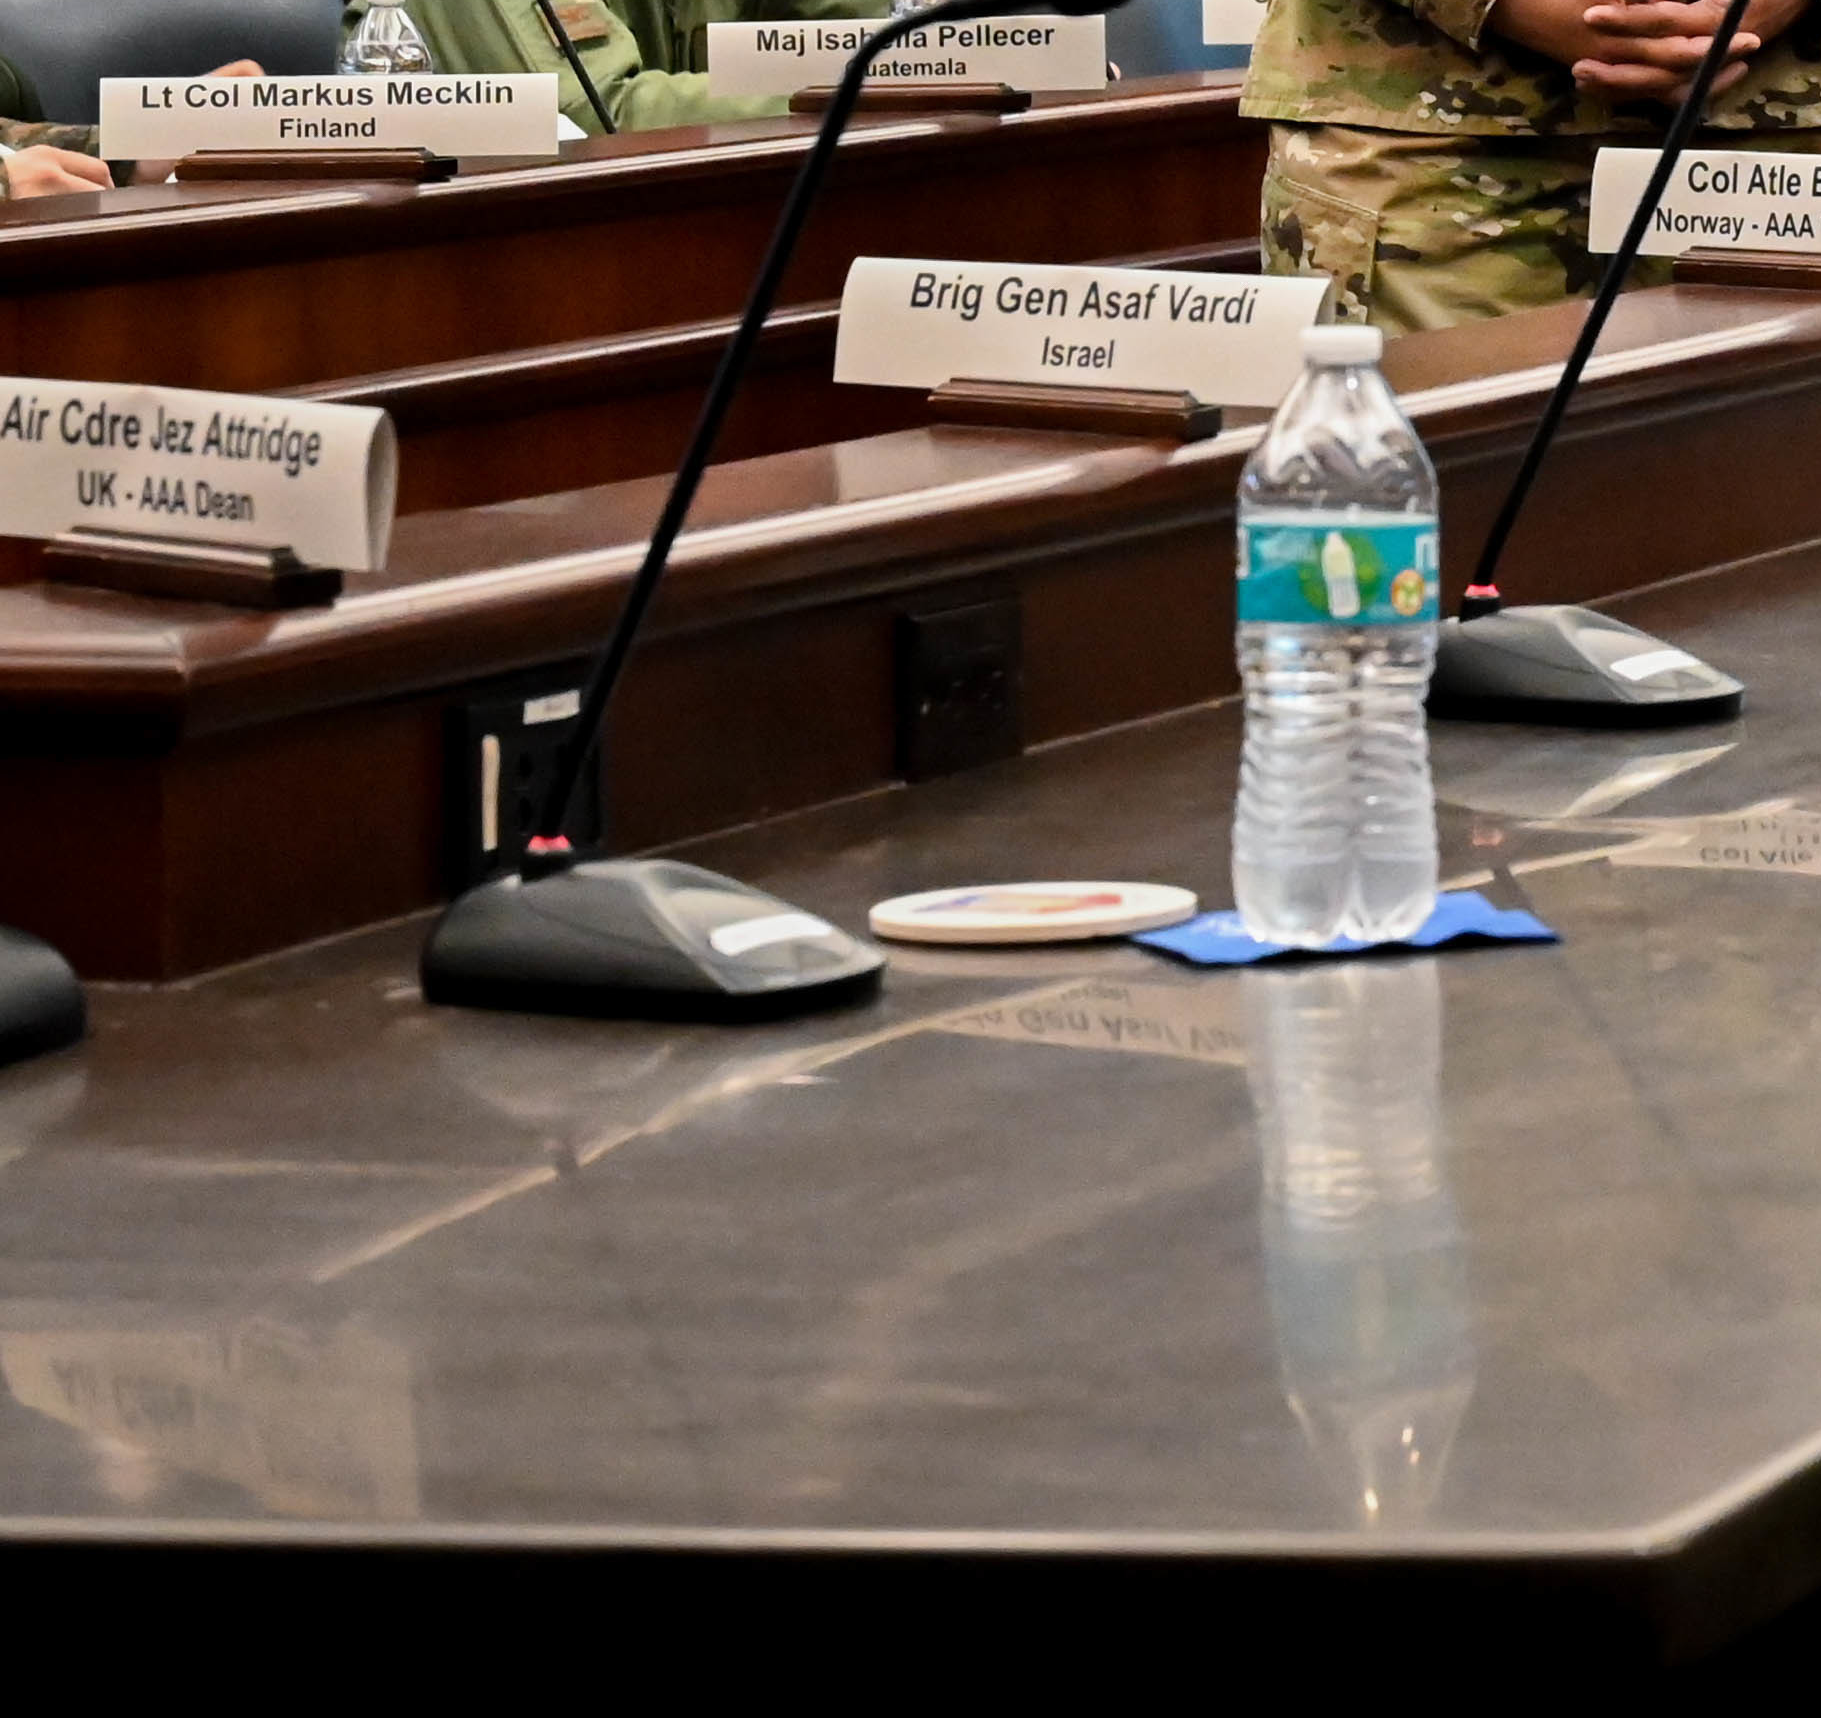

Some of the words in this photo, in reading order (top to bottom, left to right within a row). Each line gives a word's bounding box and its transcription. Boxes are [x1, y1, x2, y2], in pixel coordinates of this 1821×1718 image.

[756, 29, 805, 57] Maj
[938, 24, 1056, 47] Pellecer
[848, 58, 967, 78] uatemala
[141, 83, 172, 109] Lt
[184, 81, 240, 109] Col
[251, 79, 374, 108] Markus
[386, 78, 515, 106] Mecklin
[279, 116, 377, 139] Finland
[1688, 161, 1738, 194] Col
[1747, 164, 1802, 197] Atle
[1655, 207, 1745, 242] Norway
[1764, 212, 1815, 239] AAA
[910, 273, 980, 321] Brig
[996, 277, 1069, 318] Gen
[1079, 281, 1157, 321] Asaf
[1167, 285, 1259, 326] Vardi
[1042, 336, 1115, 370] Israel
[2, 403, 50, 443] Air
[60, 398, 141, 451] Cdre
[150, 409, 195, 455] Jez
[203, 410, 322, 477] Attridge
[76, 470, 118, 510] UK
[139, 478, 190, 518] AAA
[195, 482, 255, 524] Dean
